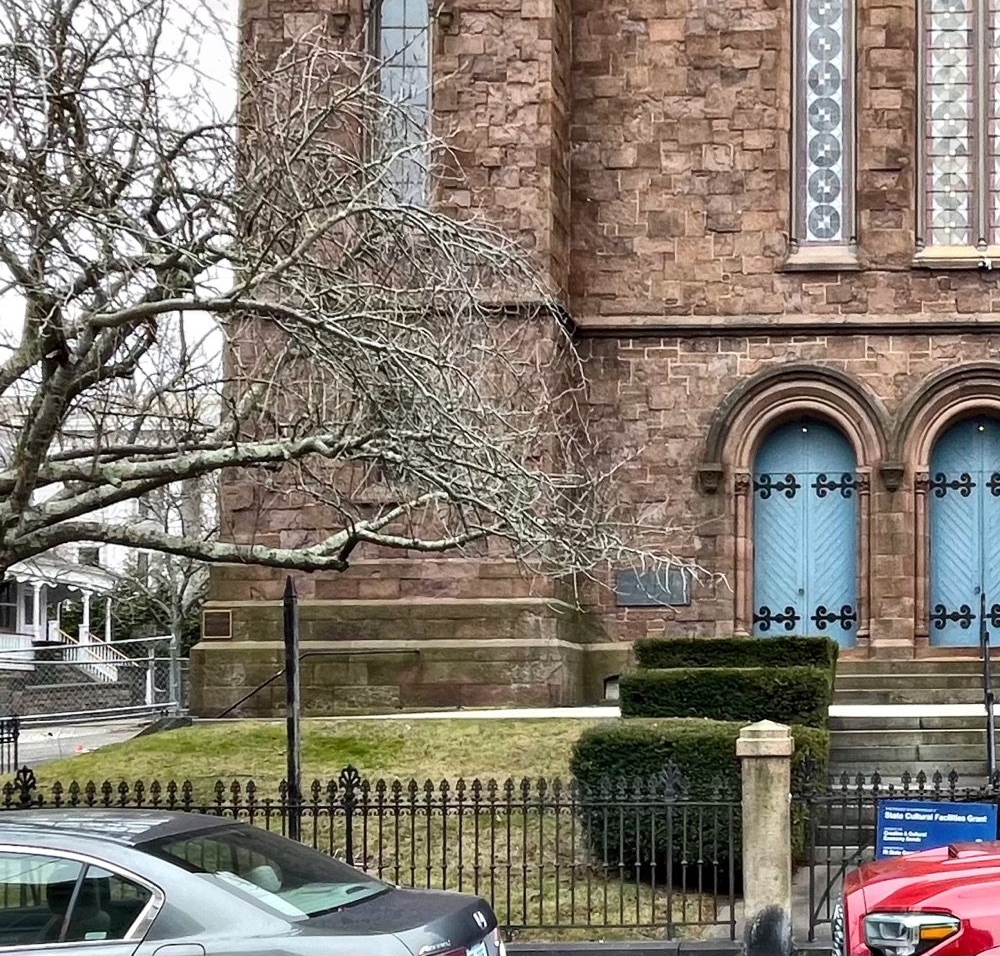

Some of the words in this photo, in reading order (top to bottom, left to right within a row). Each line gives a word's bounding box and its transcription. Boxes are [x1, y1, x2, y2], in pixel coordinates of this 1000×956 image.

[884, 811, 904, 820] State
[905, 812, 934, 821] Cultural
[934, 813, 966, 822] Facilities
[967, 814, 988, 823] Grant
